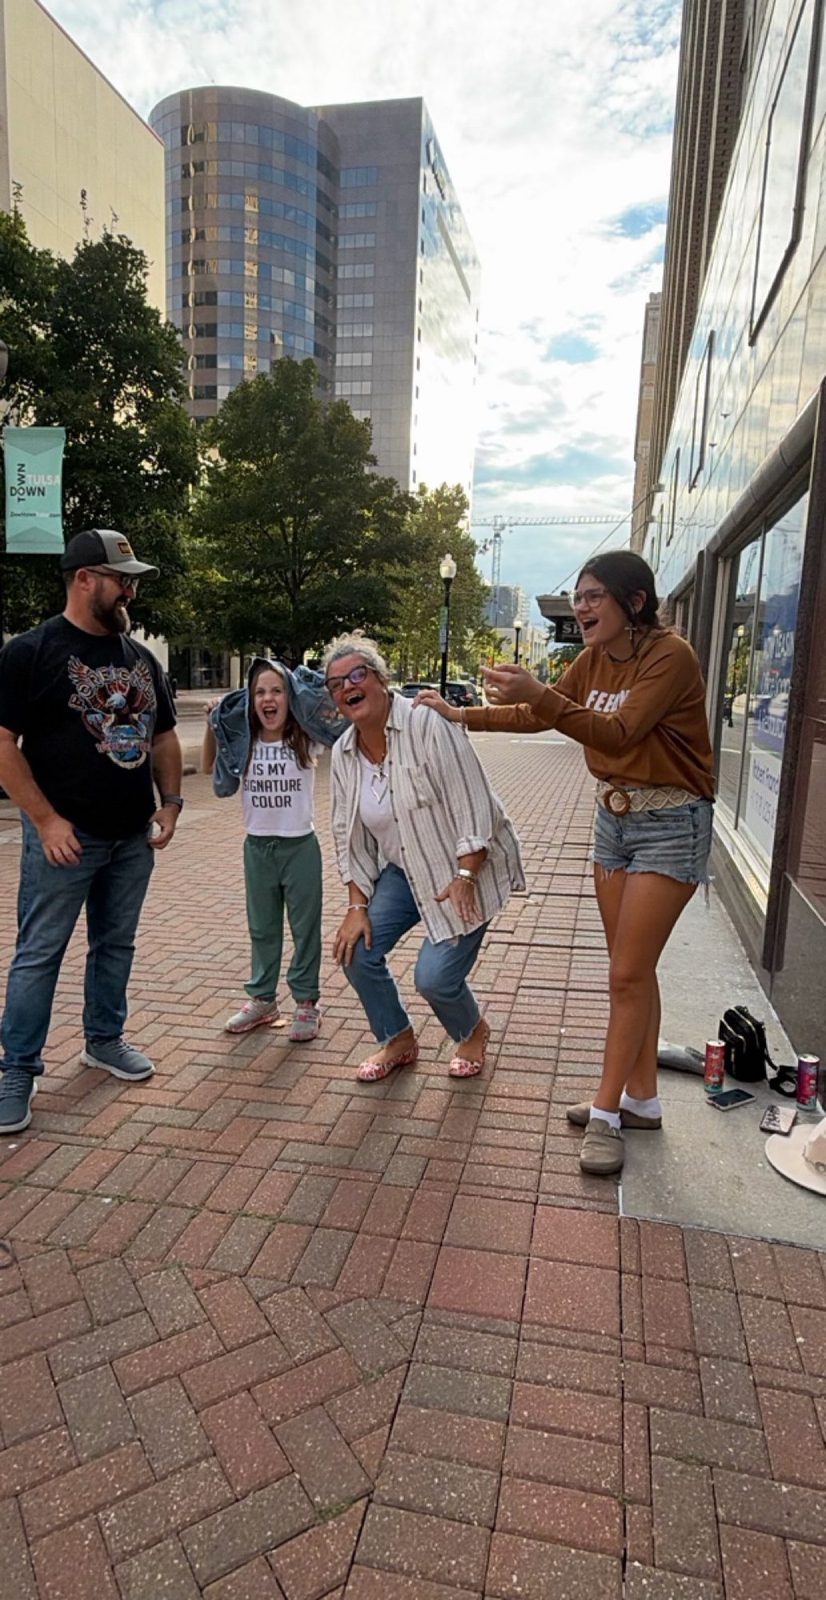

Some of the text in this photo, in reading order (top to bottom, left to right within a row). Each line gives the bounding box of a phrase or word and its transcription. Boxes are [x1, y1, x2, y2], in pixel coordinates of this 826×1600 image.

[17, 463, 26, 503] TOWN
[10, 486, 46, 497] DOWN
[253, 763, 286, 776] IS MY
[243, 778, 302, 793] SIGNATURE
[252, 795, 292, 808] COLOR
